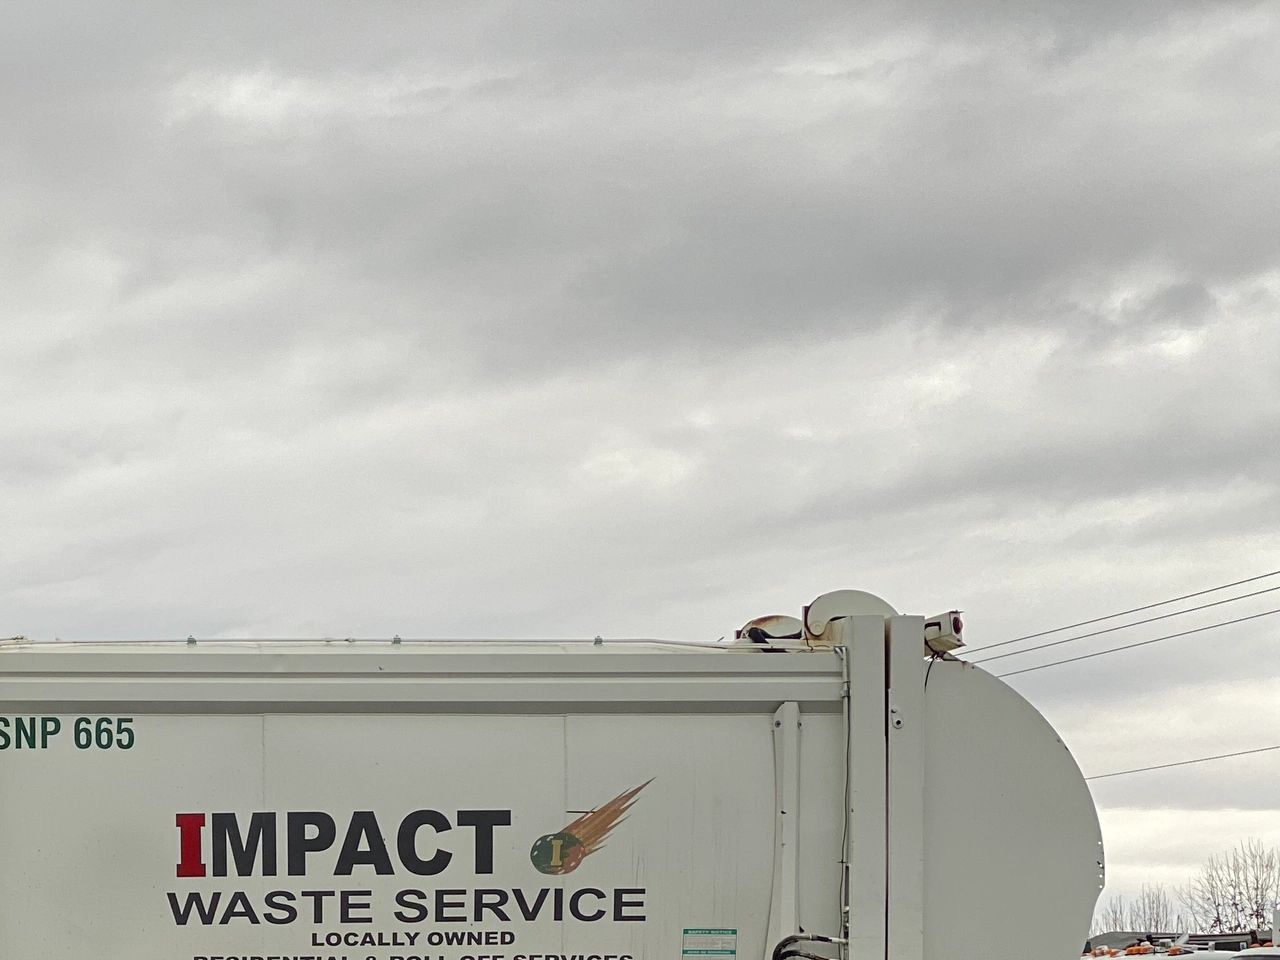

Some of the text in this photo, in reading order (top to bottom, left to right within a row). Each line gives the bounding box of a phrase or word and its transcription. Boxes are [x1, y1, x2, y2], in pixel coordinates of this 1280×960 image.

[74, 716, 135, 750] 665
[175, 810, 512, 878] IMPACT
[167, 888, 647, 925] WASTE SERVICE
[311, 931, 516, 947] LOCALLY OWNED
